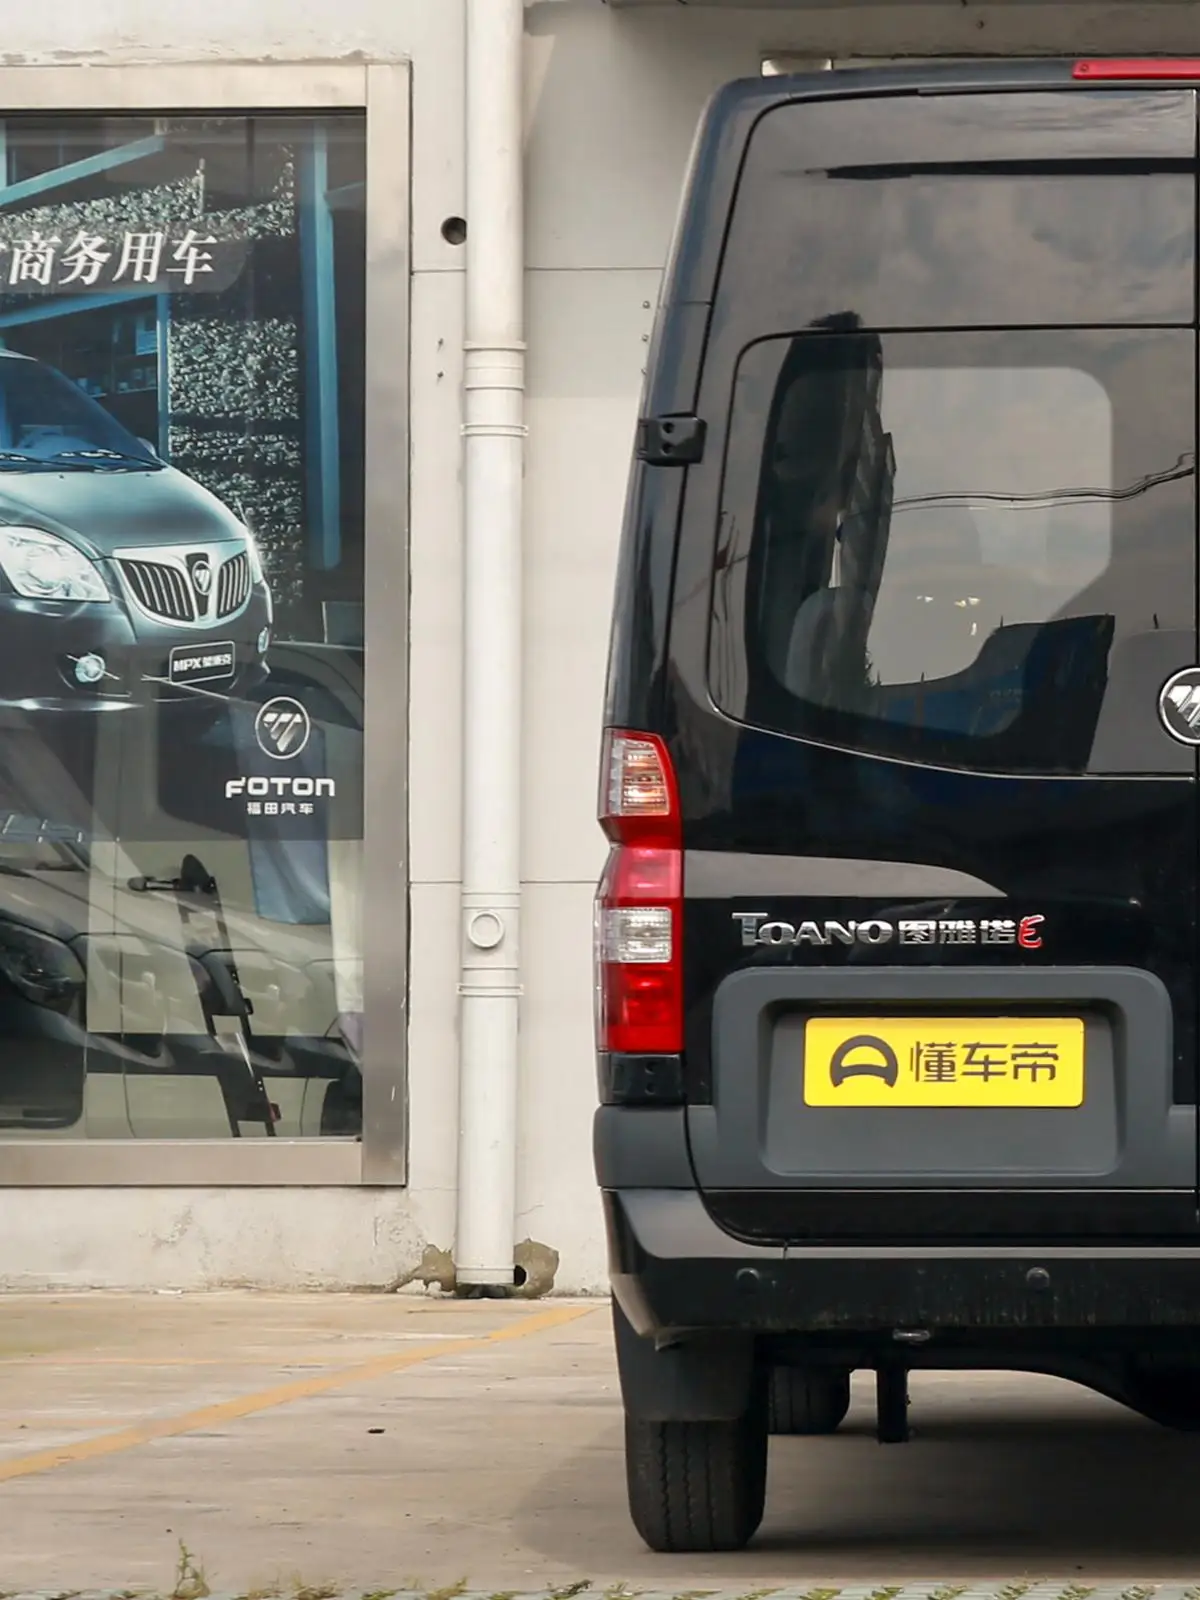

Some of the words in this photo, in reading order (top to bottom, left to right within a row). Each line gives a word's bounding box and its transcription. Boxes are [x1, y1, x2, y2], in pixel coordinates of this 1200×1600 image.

[0, 230, 217, 286] 商务用车
[225, 776, 336, 798] FOTON
[246, 802, 314, 815] 福田汽车
[909, 1041, 1060, 1083] 懂车帝
